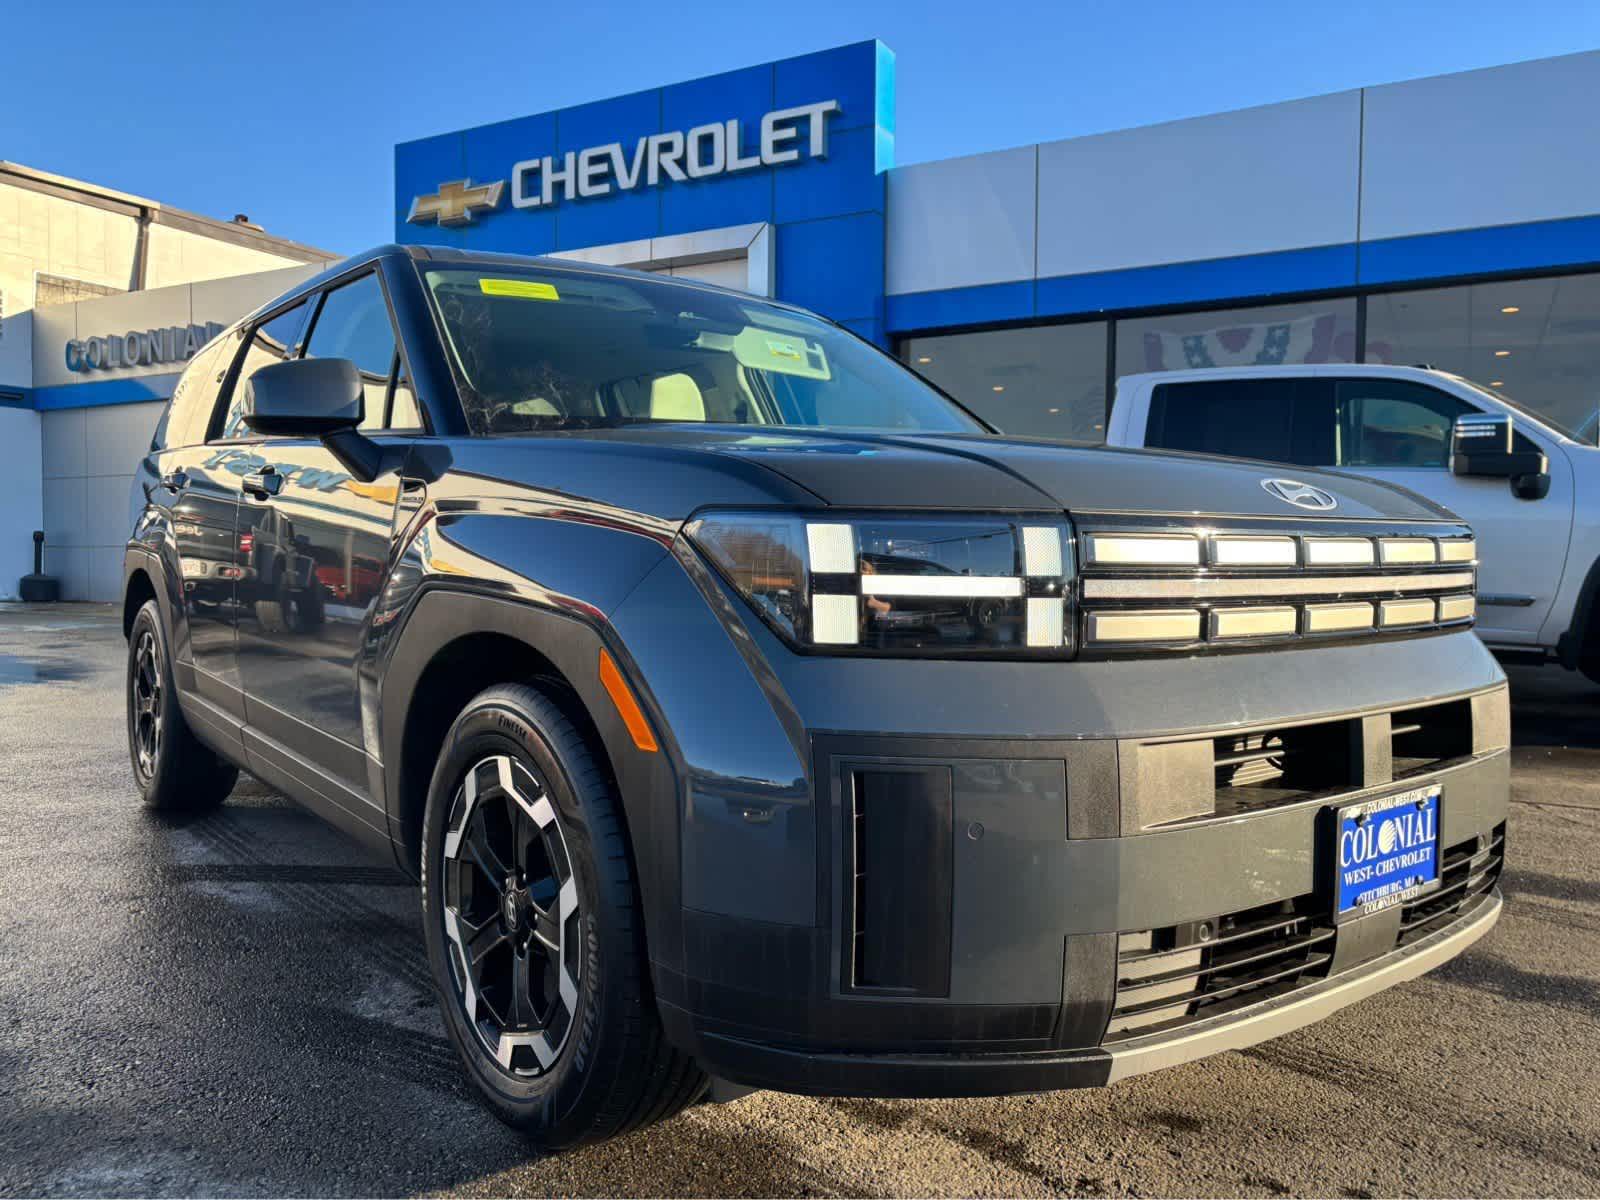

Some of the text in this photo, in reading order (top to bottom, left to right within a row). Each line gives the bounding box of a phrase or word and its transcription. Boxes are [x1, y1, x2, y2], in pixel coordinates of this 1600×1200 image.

[511, 99, 840, 209] CHEVROLET
[1341, 808, 1436, 867] COLONIAL
[1376, 847, 1431, 876] CHEVROLET
